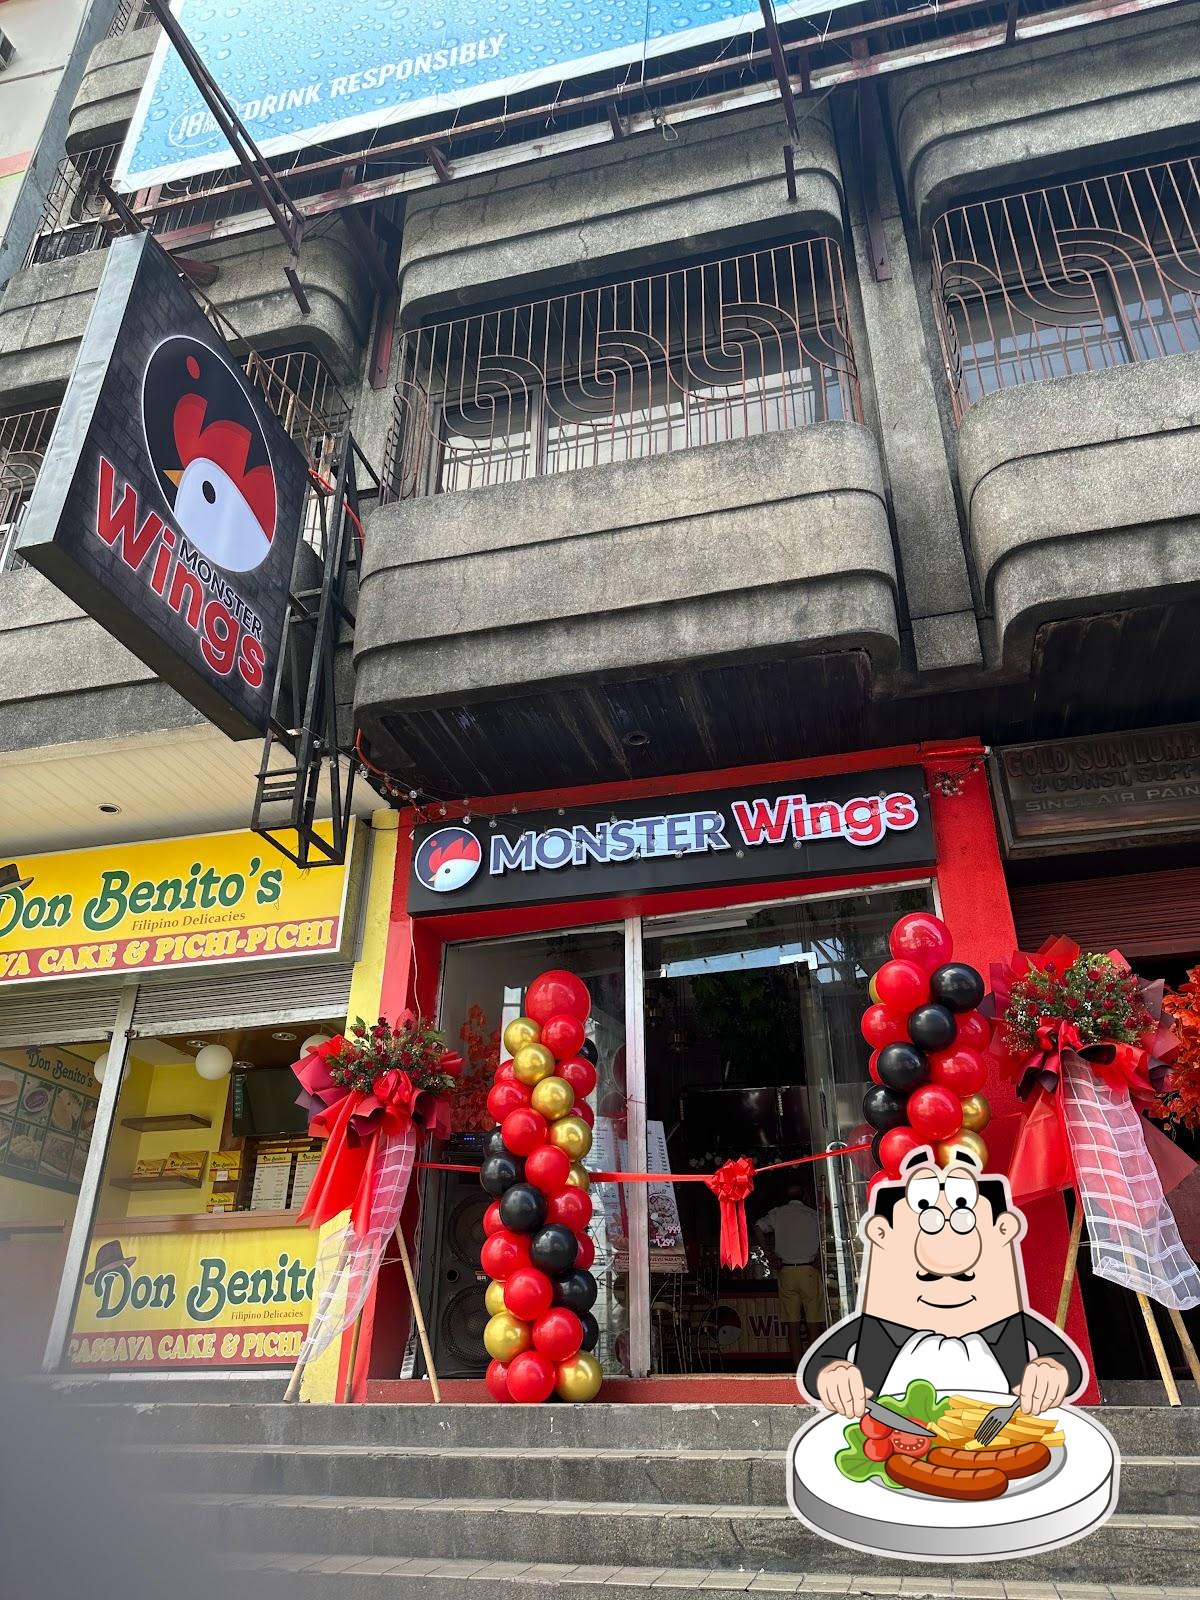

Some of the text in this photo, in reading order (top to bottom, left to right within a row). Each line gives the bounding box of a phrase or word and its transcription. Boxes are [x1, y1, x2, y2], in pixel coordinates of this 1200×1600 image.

[243, 83, 323, 121] DRINK
[330, 32, 508, 98] RESPONSIBLY
[97, 455, 265, 688] Wings
[179, 537, 262, 640] MONSTER
[1073, 743, 1127, 771] SUN
[1025, 792, 1135, 812] SINCLAIR
[489, 792, 918, 875] MONSTER Wings
[0, 857, 283, 938] Don Benito's
[131, 910, 246, 933] Filipino Delicacies
[38, 943, 117, 974] CAKE
[123, 941, 149, 965] &
[153, 919, 335, 962] PICHI-PICHI
[27, 1051, 94, 1088] Don Benito's
[95, 1264, 176, 1319] Don
[231, 1309, 304, 1321] Filipino Delicacies
[158, 1333, 216, 1360] CAKE
[221, 1333, 240, 1359] &
